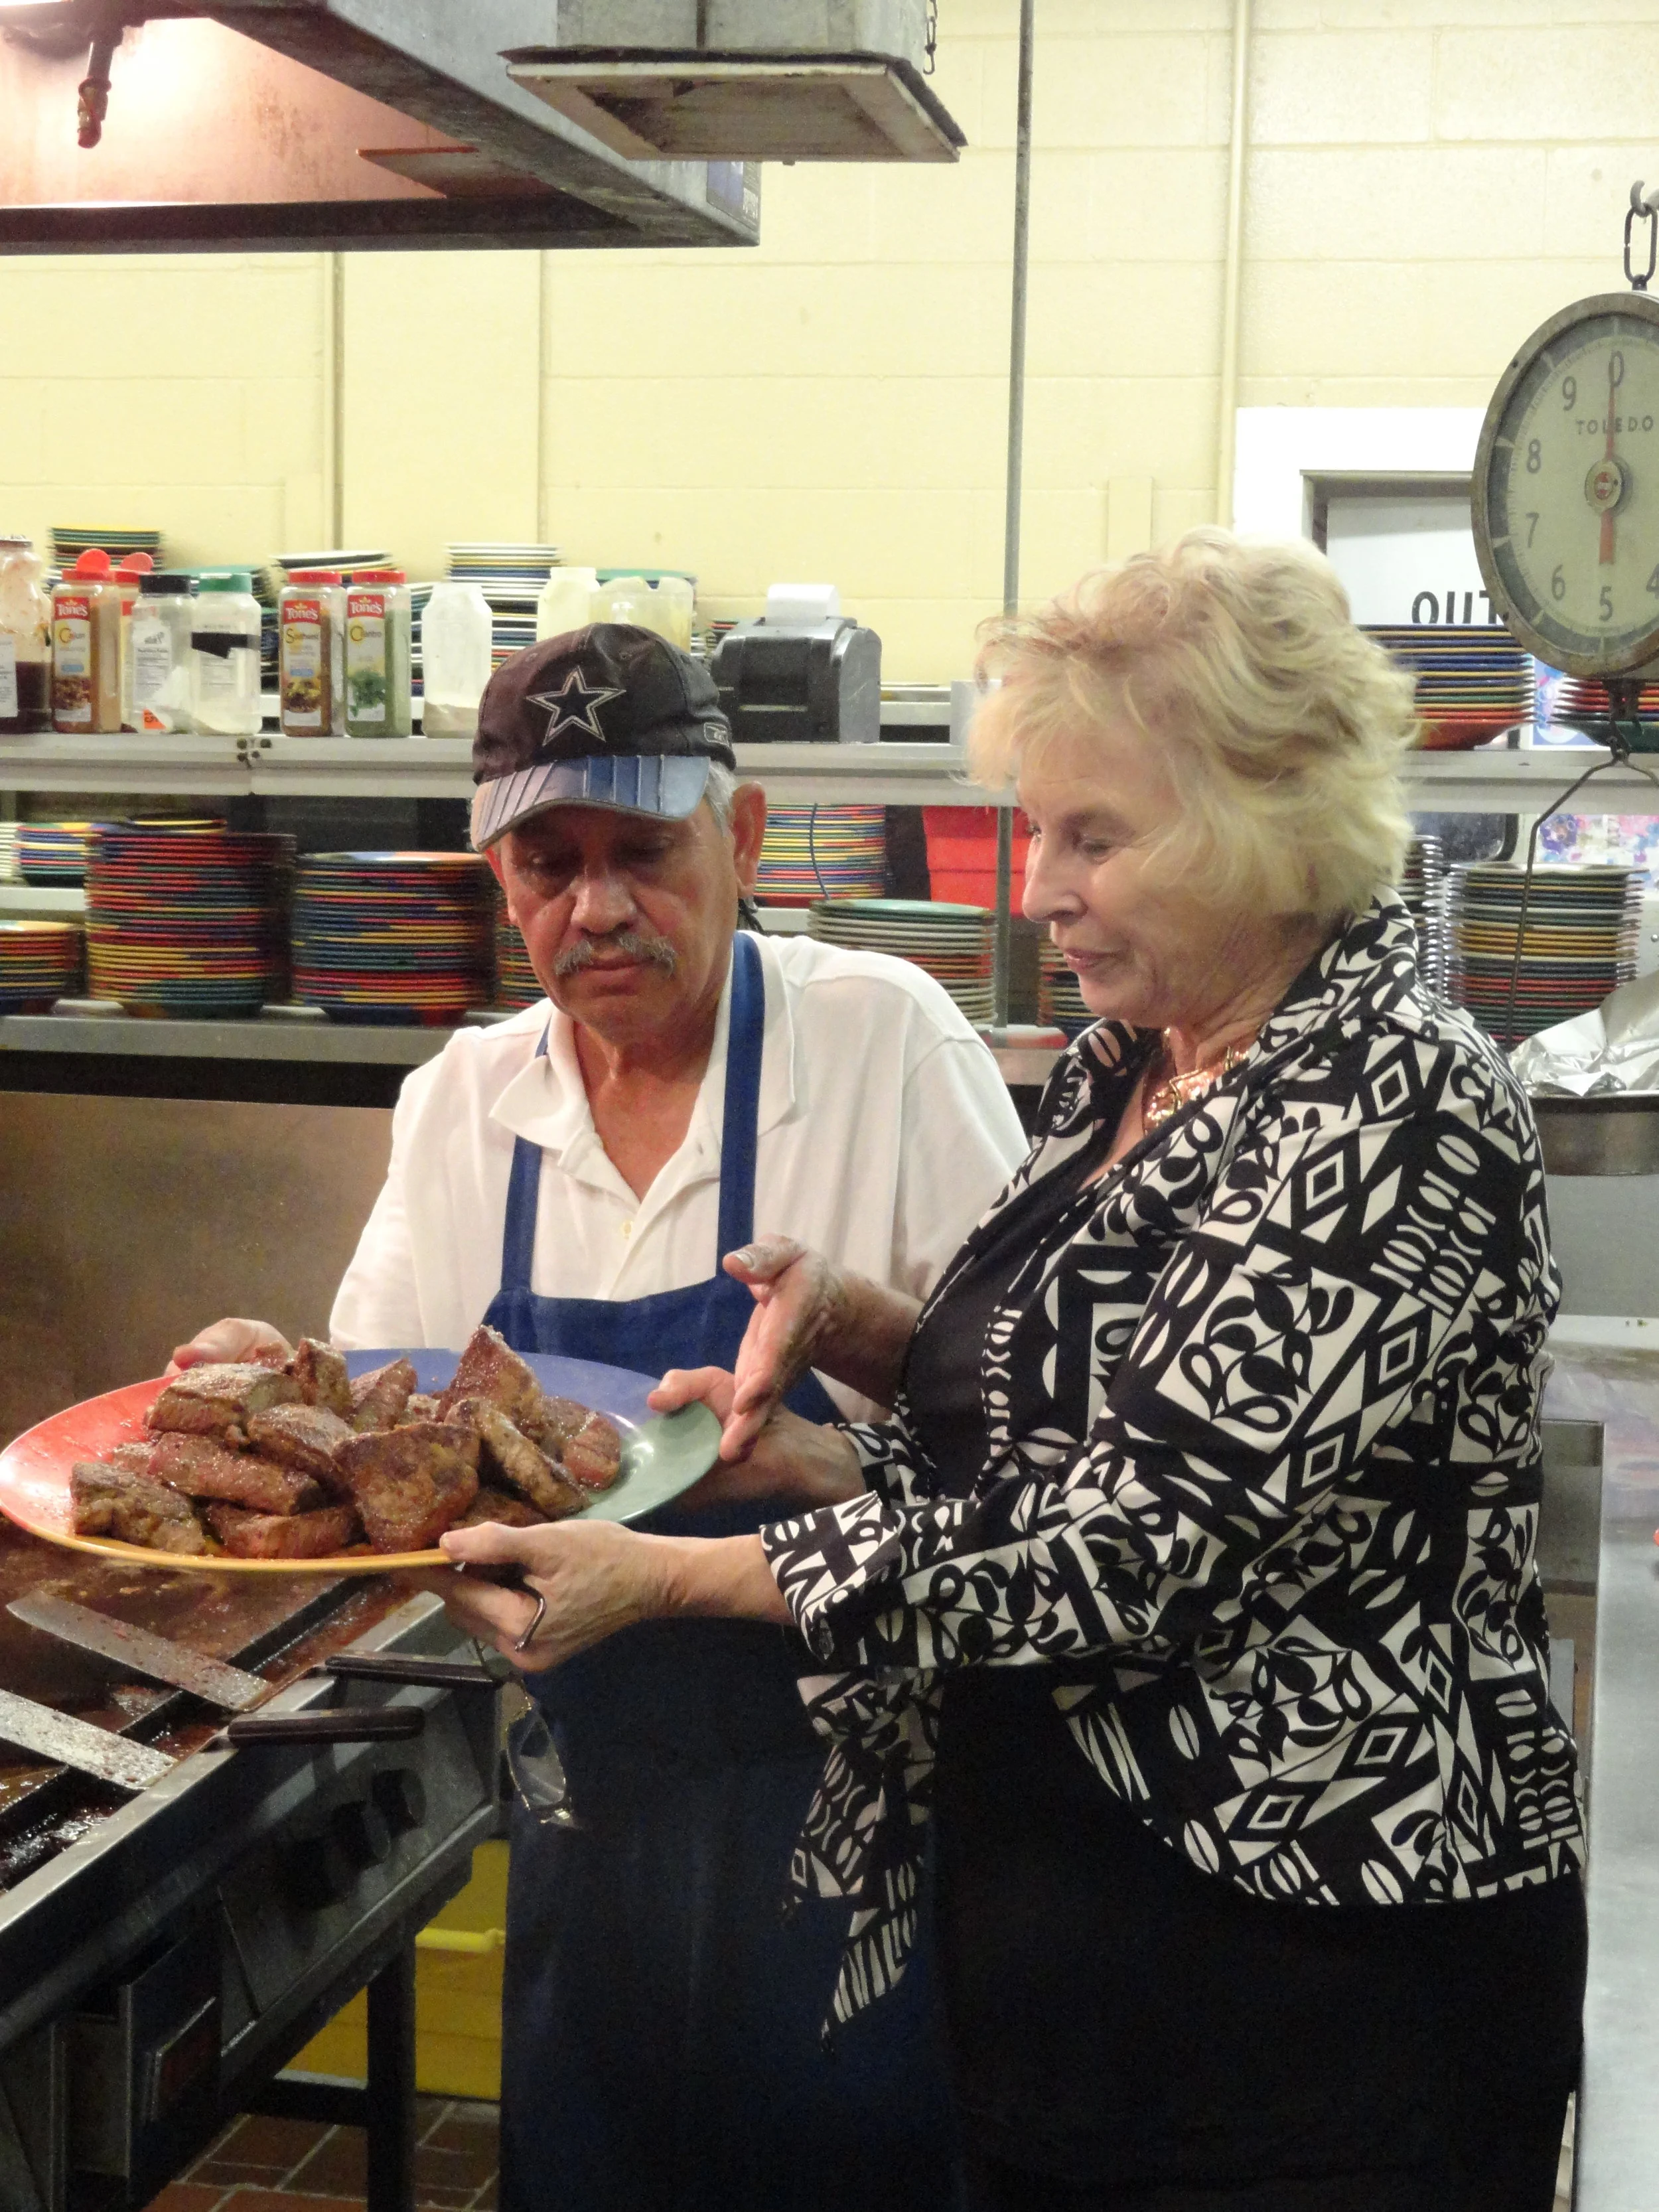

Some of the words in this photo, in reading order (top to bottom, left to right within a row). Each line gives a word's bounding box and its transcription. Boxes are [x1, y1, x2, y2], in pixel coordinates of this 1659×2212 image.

[1561, 376, 1577, 411] 9
[1576, 415, 1654, 435] TOLEDO
[1526, 439, 1542, 474] 8
[1525, 512, 1540, 549] 7
[1551, 564, 1566, 601] 6
[1599, 585, 1614, 621] 5
